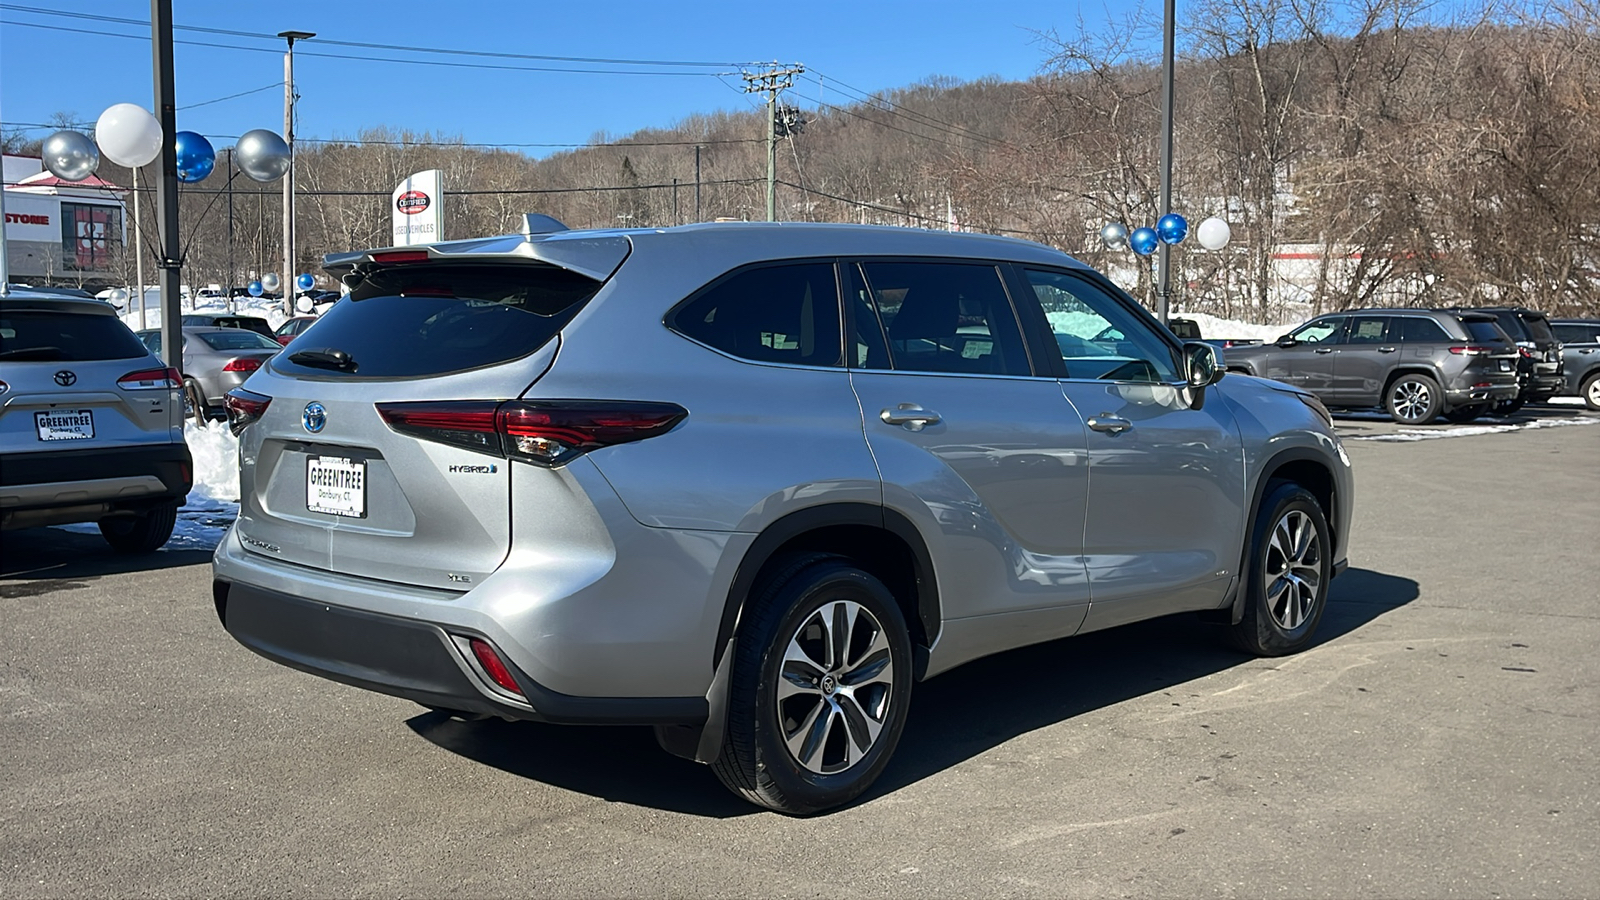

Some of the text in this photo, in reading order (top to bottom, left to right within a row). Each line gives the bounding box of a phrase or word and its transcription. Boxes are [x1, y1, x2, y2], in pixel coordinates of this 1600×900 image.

[399, 199, 426, 207] CERTIFIED
[395, 224, 434, 235] USED VEHICLES
[39, 415, 91, 428] GREENTREE
[449, 464, 490, 474] HYBRID
[310, 466, 362, 490] GREENTREE
[318, 488, 342, 503] Danbury,
